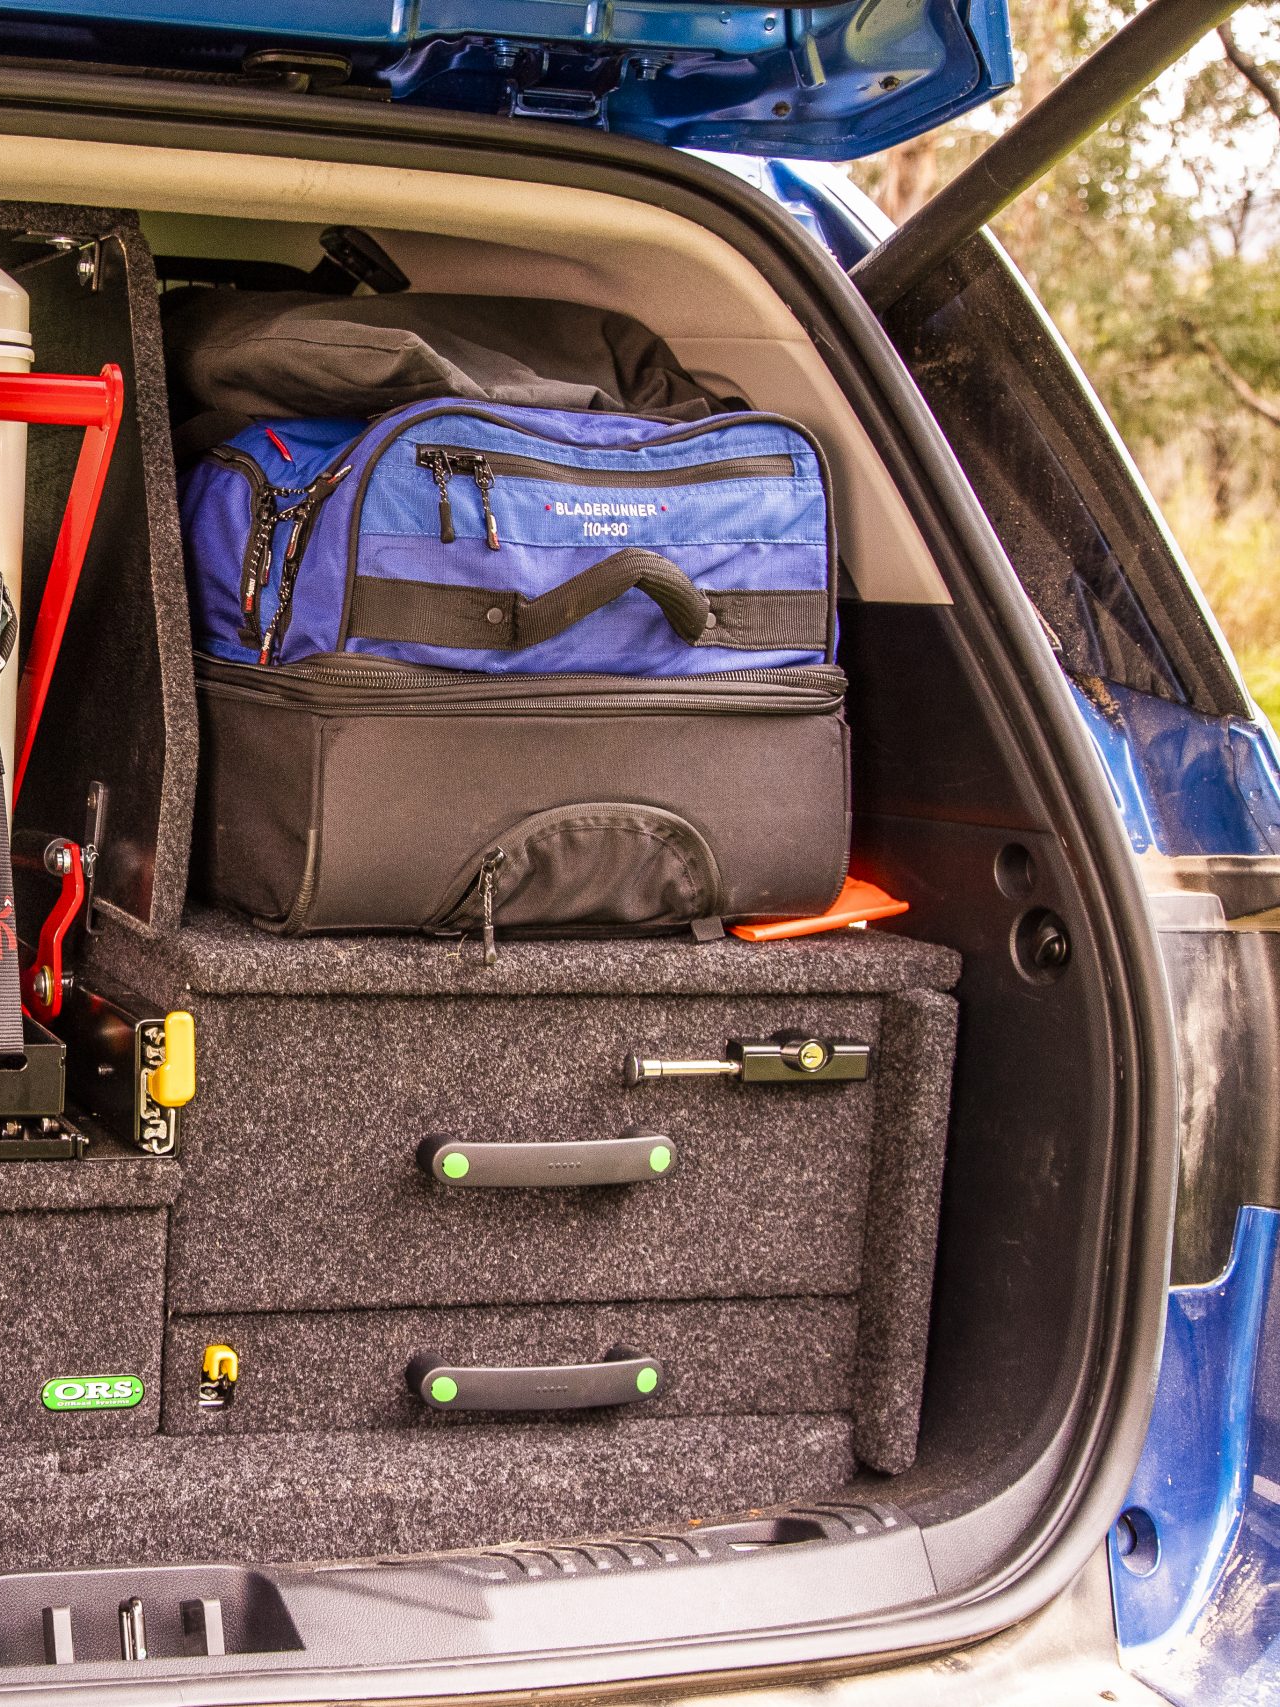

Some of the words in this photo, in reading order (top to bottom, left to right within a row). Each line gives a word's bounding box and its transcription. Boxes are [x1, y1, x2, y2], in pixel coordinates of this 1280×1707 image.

[555, 501, 658, 517] BLADERUNNER
[583, 521, 629, 537] 110+30
[54, 1380, 133, 1400] ORS
